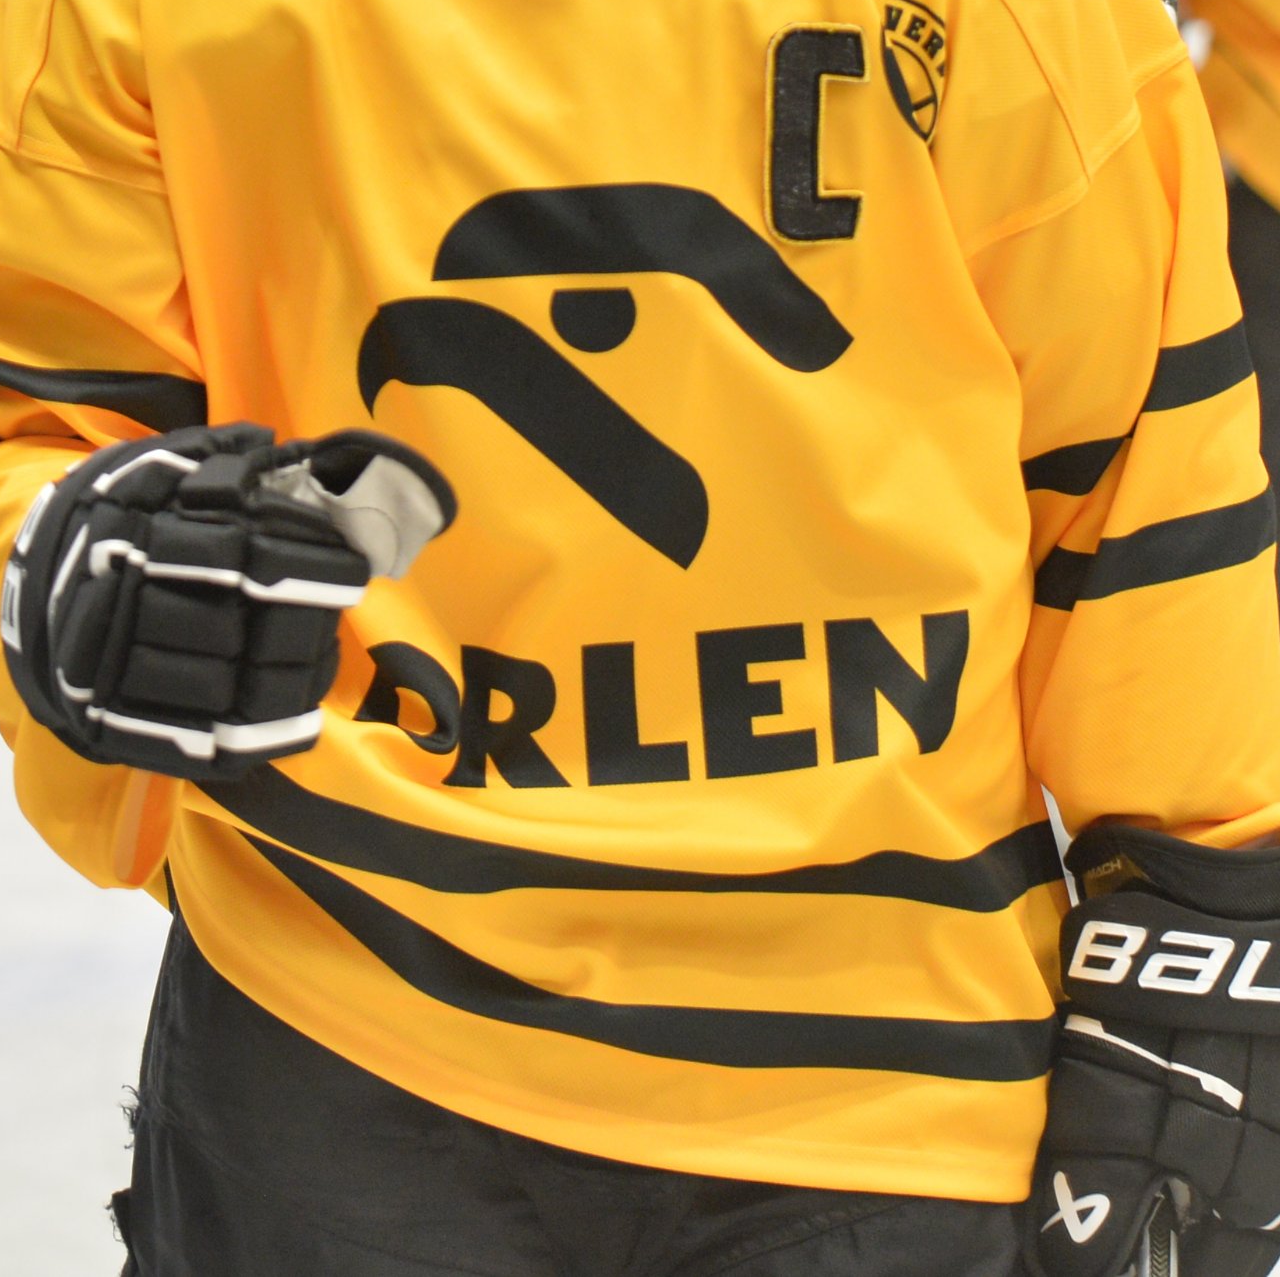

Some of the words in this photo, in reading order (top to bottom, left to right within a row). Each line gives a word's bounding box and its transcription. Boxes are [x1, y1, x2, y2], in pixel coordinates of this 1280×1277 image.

[884, 4, 946, 79] VER
[770, 25, 867, 243] C
[352, 609, 970, 790] ORLEN
